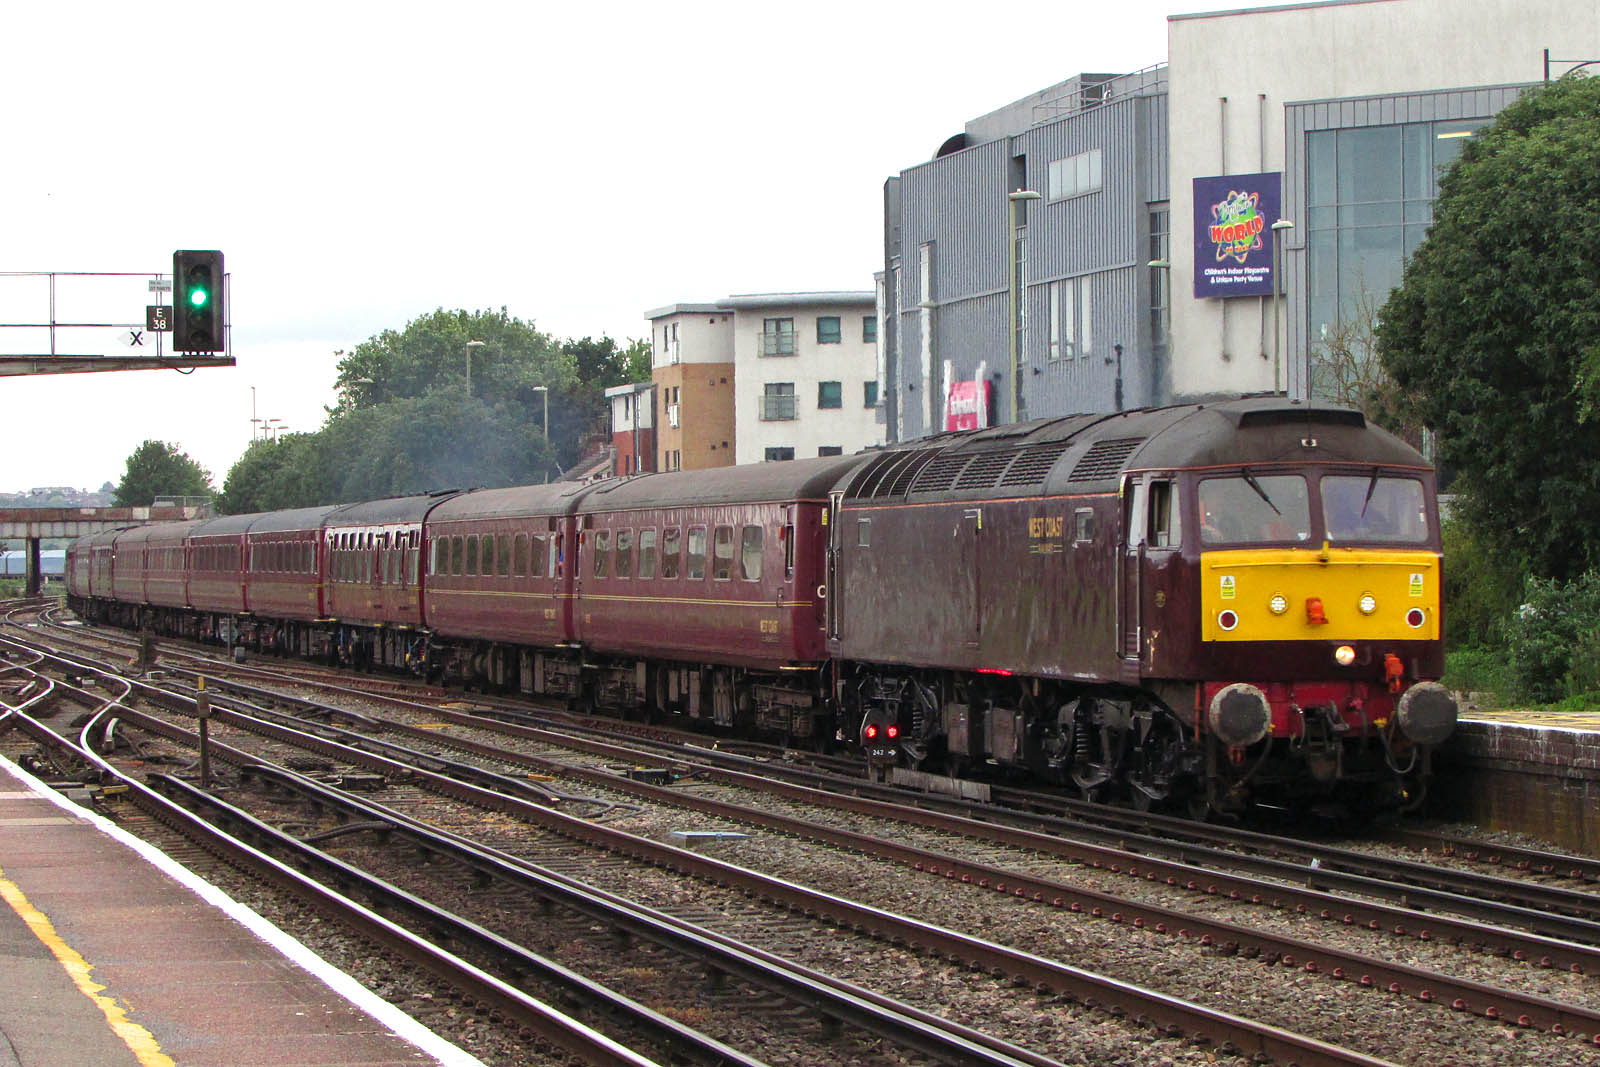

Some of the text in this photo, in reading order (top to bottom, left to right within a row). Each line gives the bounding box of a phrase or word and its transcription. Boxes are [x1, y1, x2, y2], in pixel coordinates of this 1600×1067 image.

[1211, 215, 1264, 243] WORLD
[1228, 267, 1243, 275] Indoor
[1233, 275, 1247, 284] Party
[156, 307, 163, 318] E
[153, 319, 167, 330] 38
